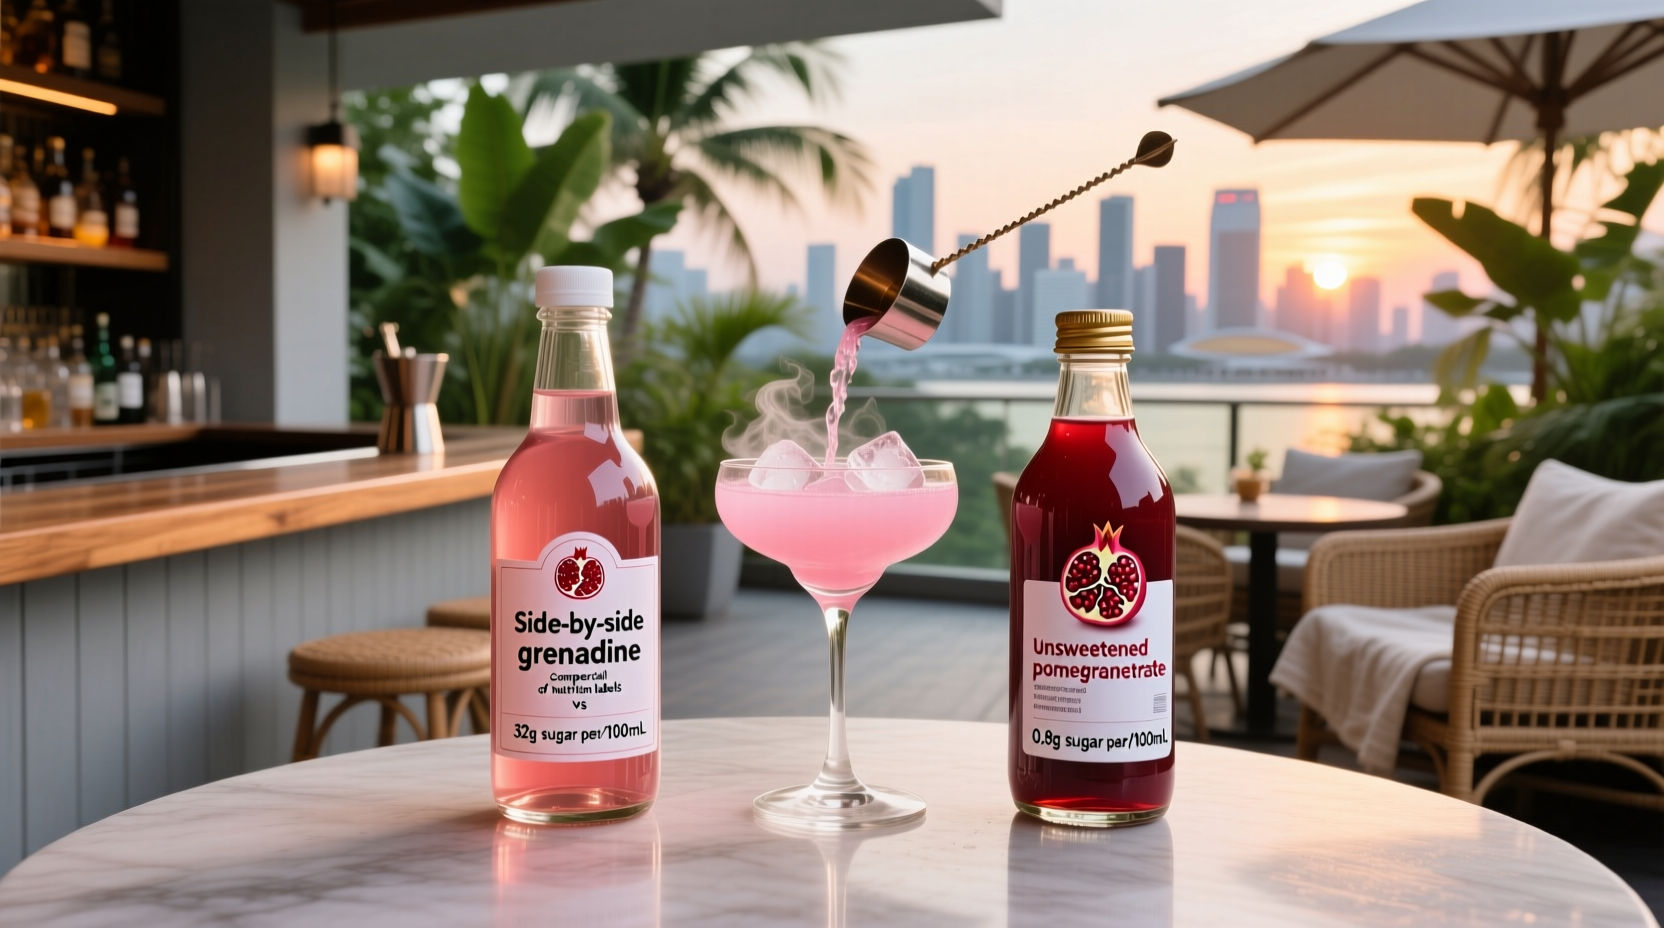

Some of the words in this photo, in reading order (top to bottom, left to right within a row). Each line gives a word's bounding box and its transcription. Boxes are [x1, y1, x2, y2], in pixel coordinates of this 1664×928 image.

[514, 609, 644, 640] Side-by-side
[518, 639, 641, 671] grenadine
[1033, 638, 1149, 657] Unsweetened
[1033, 660, 1167, 684] pomegranetrate
[513, 723, 537, 744] 32g
[541, 730, 578, 744] sugar
[1065, 736, 1104, 752] sugar
